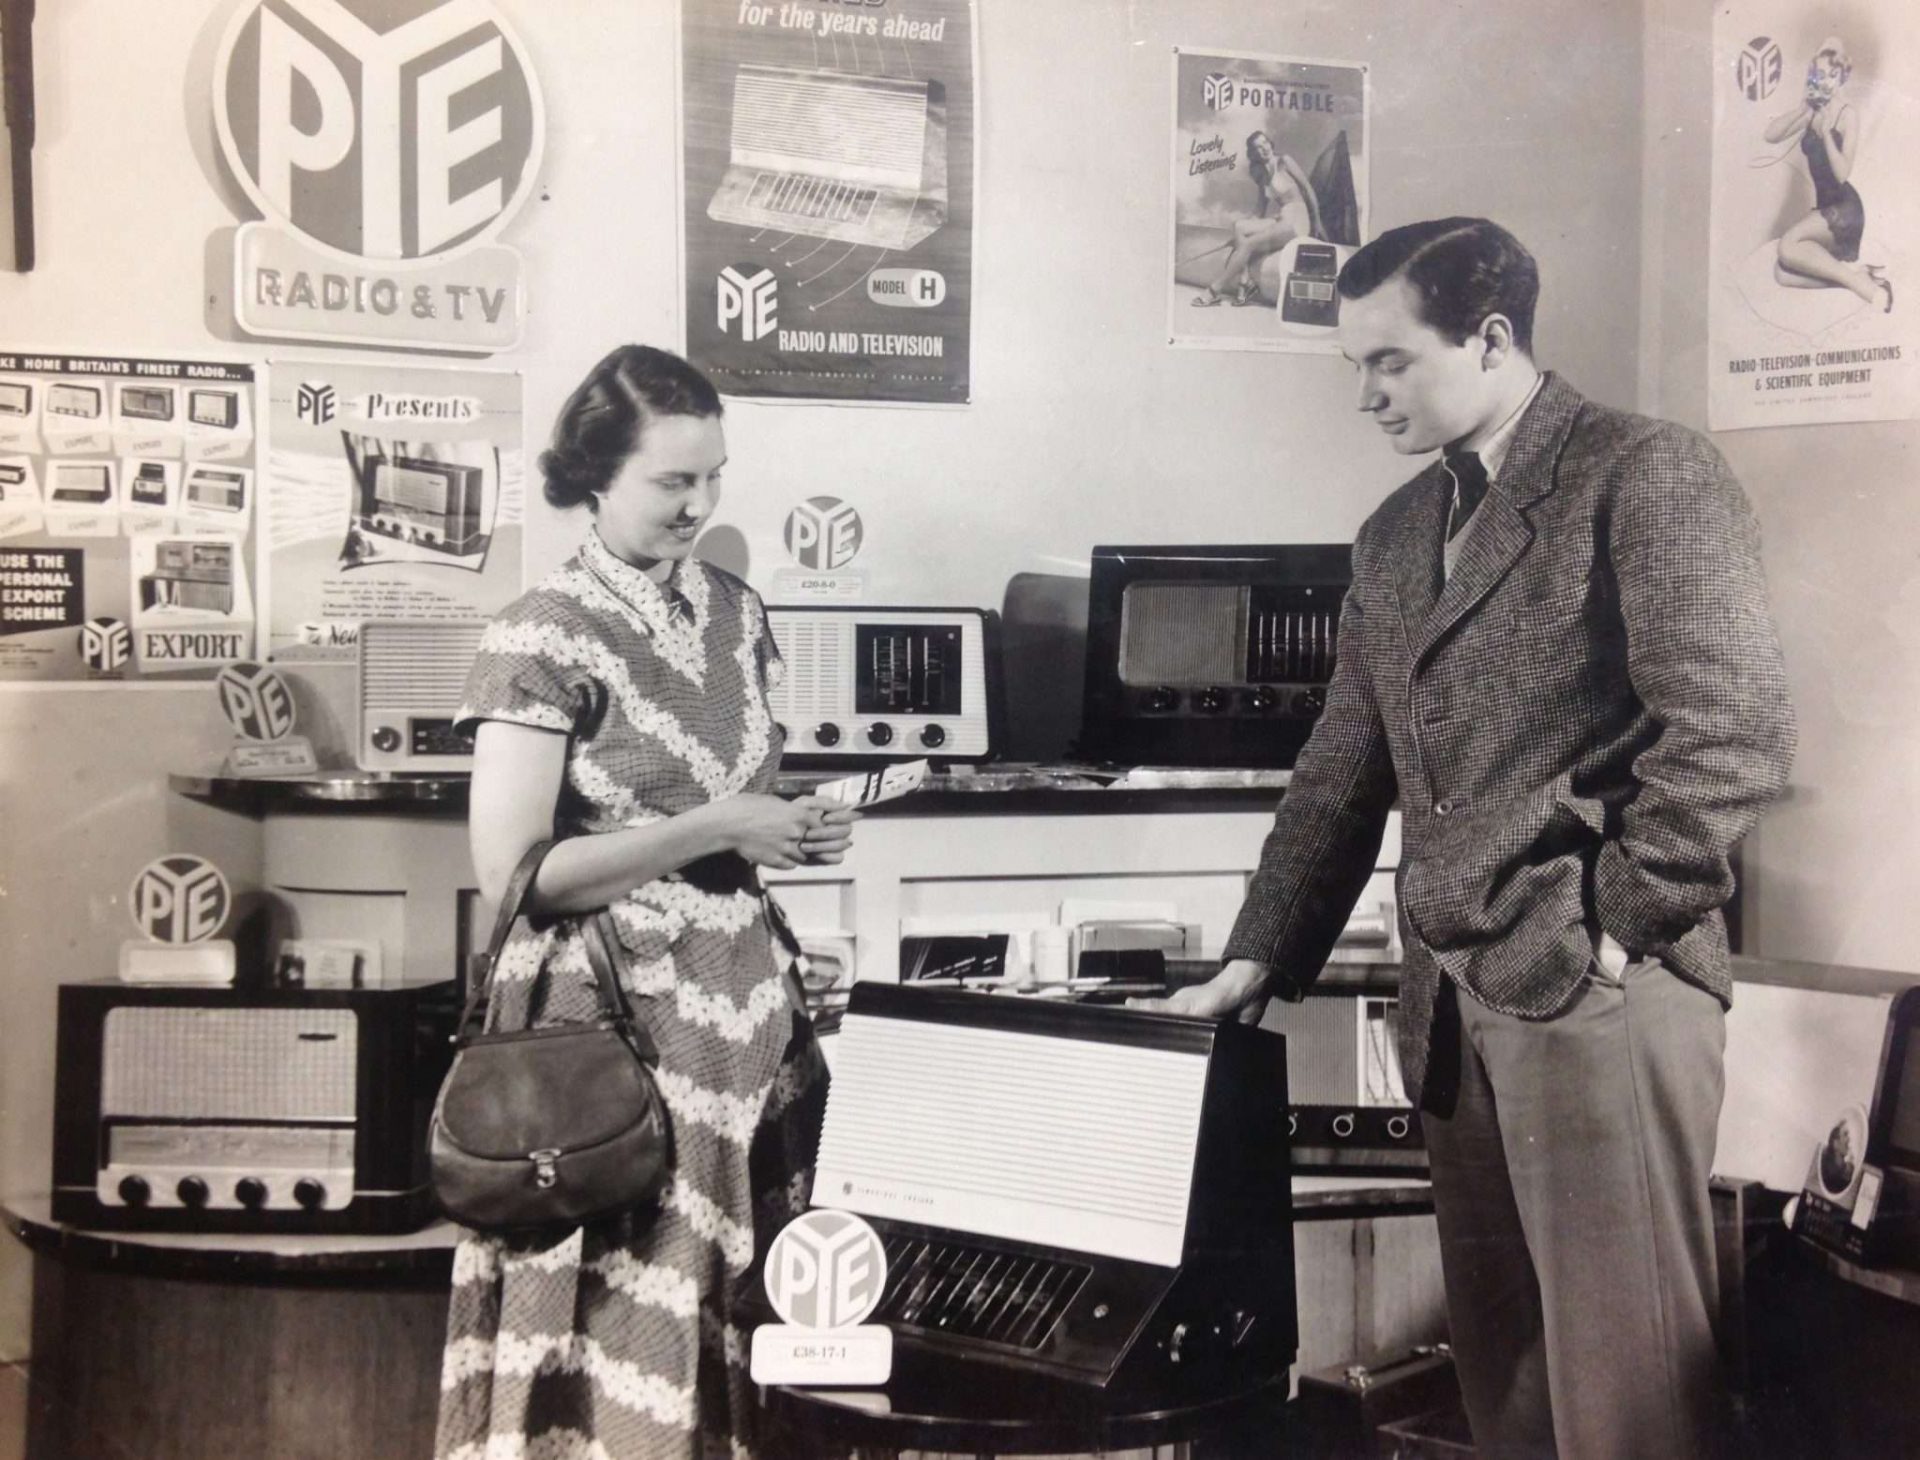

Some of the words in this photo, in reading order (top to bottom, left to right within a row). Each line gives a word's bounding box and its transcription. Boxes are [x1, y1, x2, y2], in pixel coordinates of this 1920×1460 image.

[738, 0, 776, 26] for
[780, 5, 815, 29] the
[818, 12, 877, 37] years
[882, 15, 945, 42] ahead
[1204, 74, 1233, 110] PYE
[1240, 87, 1335, 113] PORTABLE
[257, 0, 502, 257] PYE
[256, 267, 398, 316] RADIO
[410, 285, 437, 319] &
[445, 285, 506, 323] TV
[717, 266, 777, 341] PYE
[872, 279, 906, 295] MODEL
[919, 278, 937, 300] H
[778, 330, 825, 352] RADIO
[828, 332, 859, 354] AND
[862, 334, 944, 357] TELEVISION
[24, 358, 62, 370] HOME
[69, 359, 130, 374] BRITAIN'S
[137, 362, 181, 376] FINEST
[1766, 373, 1814, 391] SCIENTIFIC
[1818, 369, 1872, 387] EQUIPMENT
[298, 382, 336, 426] PYE
[367, 393, 473, 420] Presents
[791, 500, 858, 570] PYE
[0, 554, 29, 568] USE
[33, 555, 65, 569] THE
[3, 589, 66, 603] EXPORT
[3, 606, 66, 620] SCHEME
[84, 620, 130, 672] PYE
[146, 633, 243, 659] EXPORT
[221, 662, 292, 741] PYE
[141, 860, 219, 945] PYE
[780, 1220, 871, 1330] PYE
